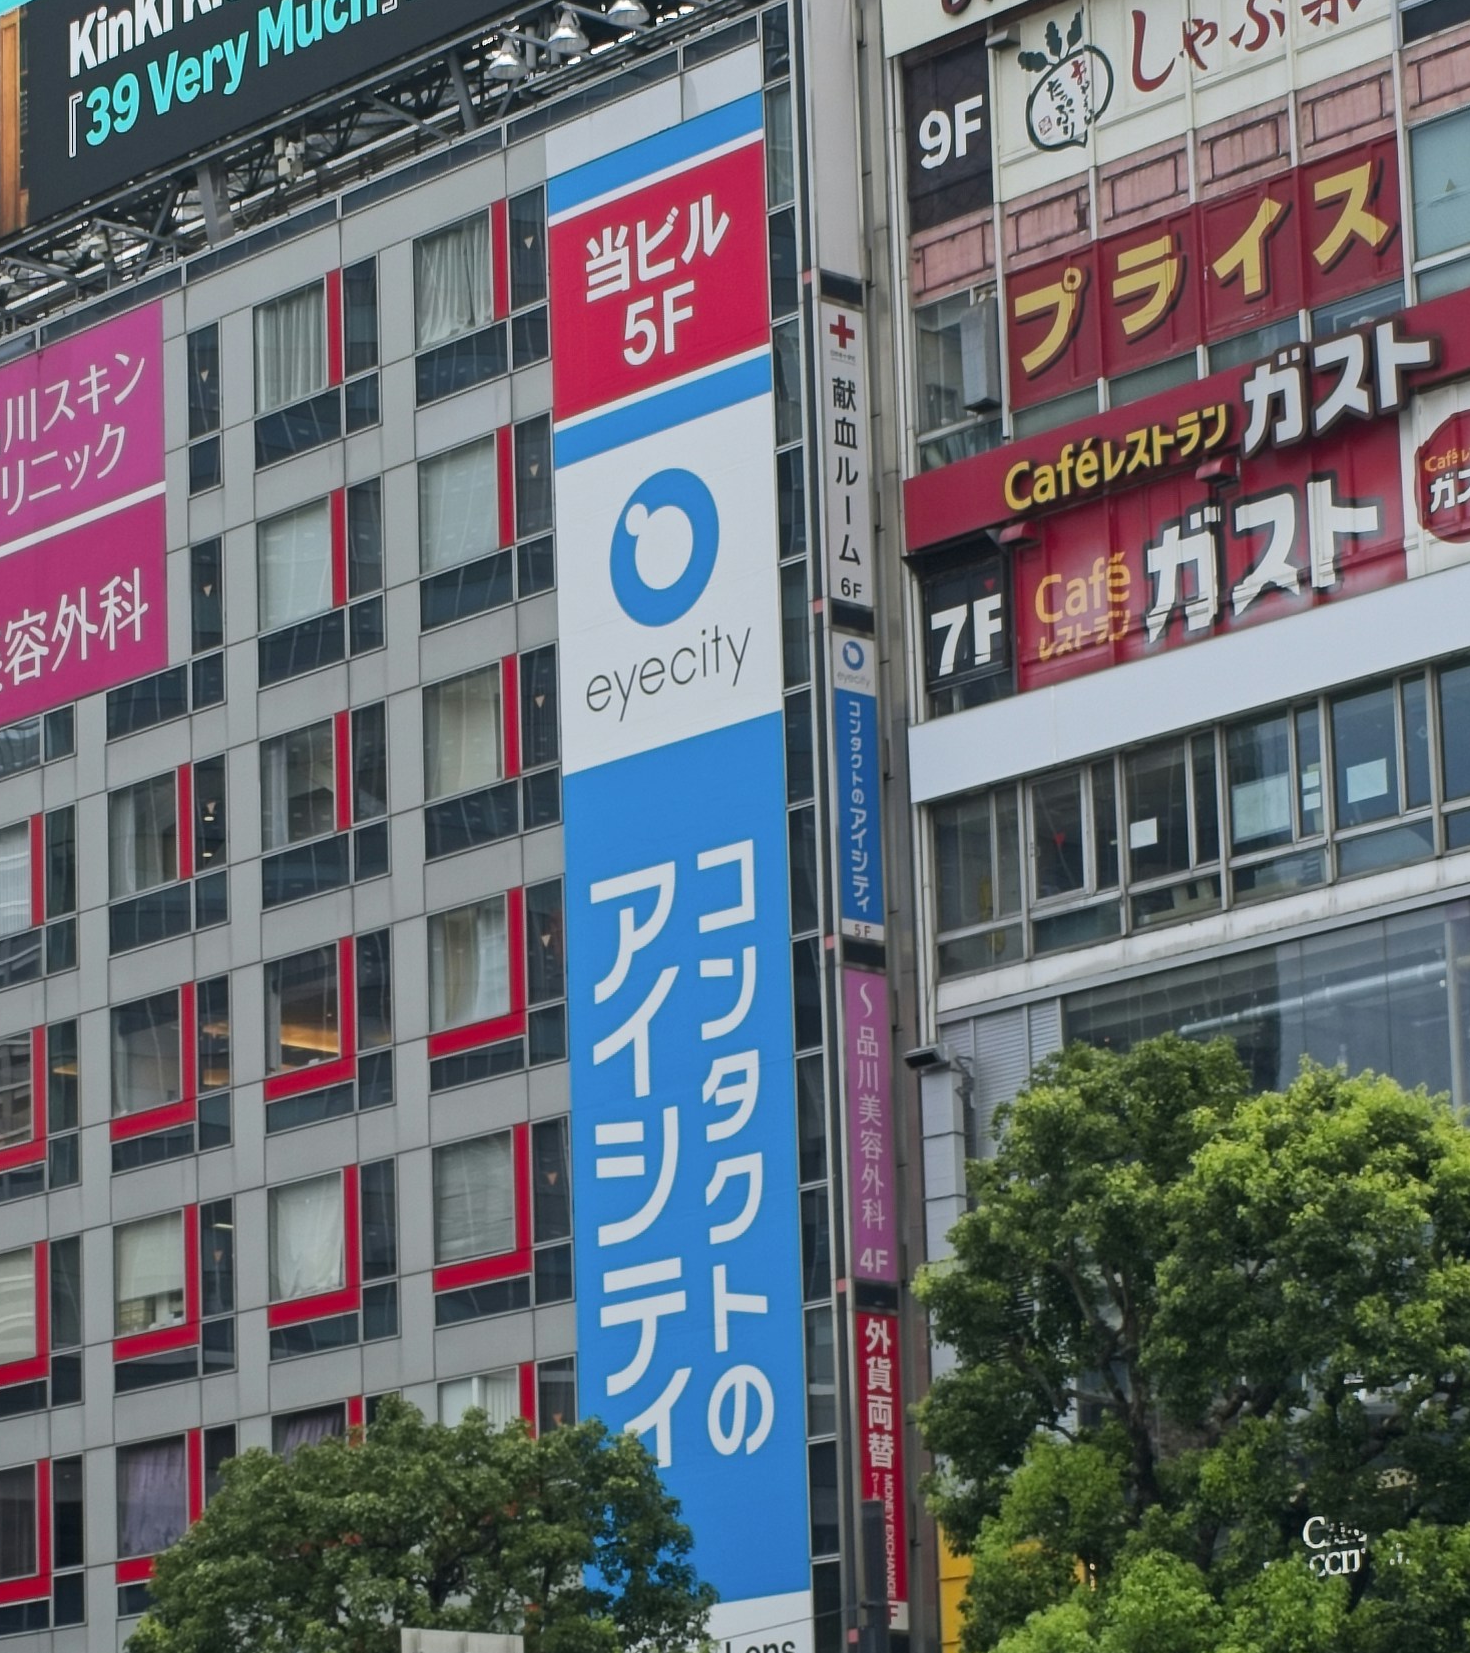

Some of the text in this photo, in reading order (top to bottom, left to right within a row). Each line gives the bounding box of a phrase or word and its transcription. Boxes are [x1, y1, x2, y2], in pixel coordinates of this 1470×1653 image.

[66, 30, 249, 157] 『39 Very
[917, 94, 985, 171] 9F
[1045, 78, 1075, 140] たっぷり
[584, 191, 731, 305] 当ビル
[1013, 160, 1391, 379] プライス
[621, 279, 696, 368] 5F
[1241, 318, 1436, 456] ガスト
[830, 376, 862, 567] 献血ルーム
[839, 575, 863, 600] 6F
[1034, 551, 1132, 631] Café
[1143, 473, 1379, 645] ガスト
[585, 624, 753, 724] eyecity
[929, 591, 1005, 680] 7F
[848, 700, 871, 913] コンタクトのアイシティ
[853, 923, 872, 938] 5F
[588, 858, 694, 1471] アイシティ
[695, 838, 777, 1458] コンタクトの
[856, 1025, 886, 1231] 品川美容外科
[859, 1248, 889, 1274] 4F
[864, 1317, 895, 1470] 外貨両替
[883, 1474, 897, 1600] MONEY EXCHANGE
